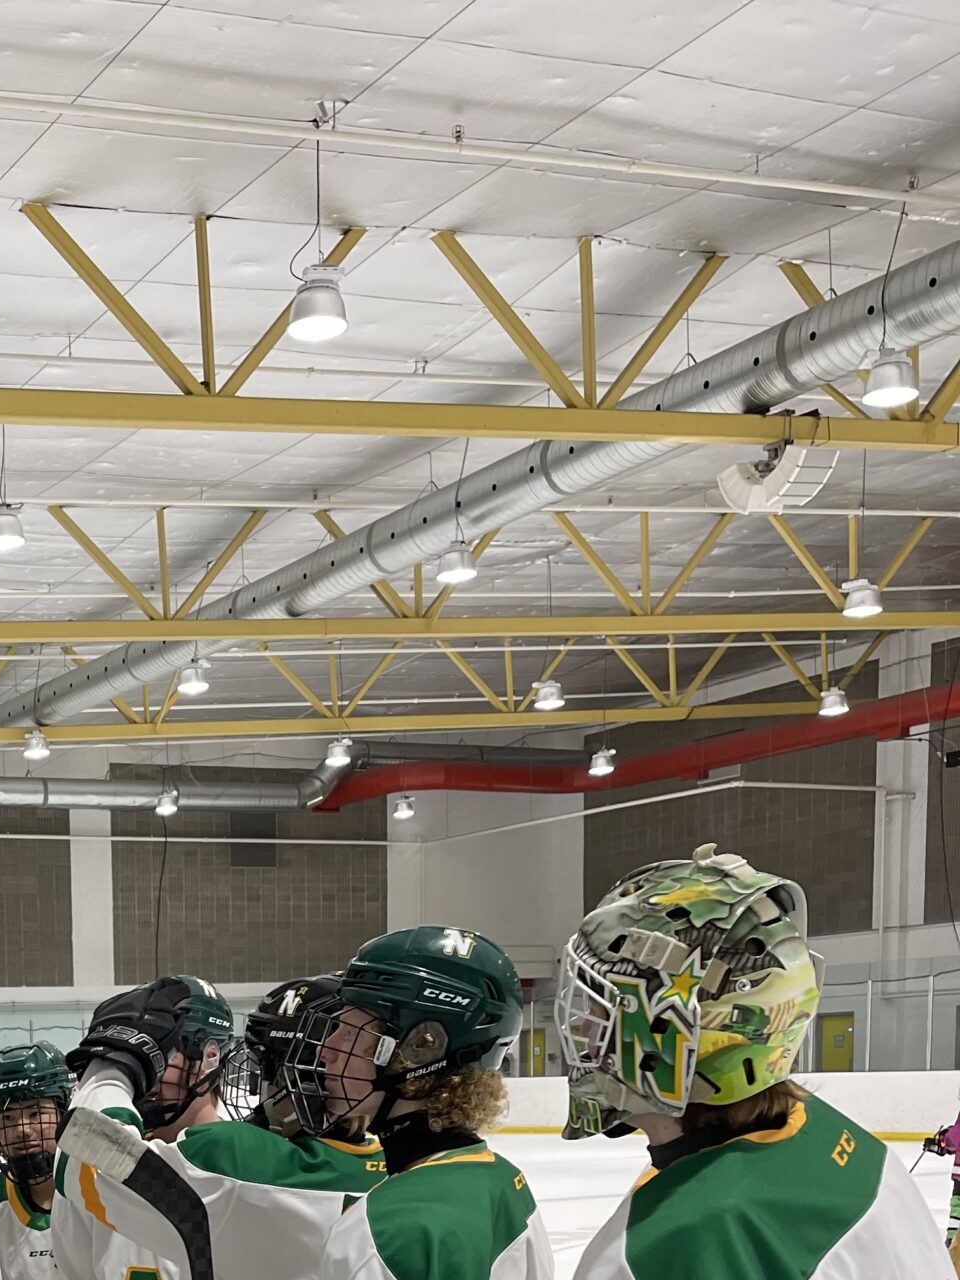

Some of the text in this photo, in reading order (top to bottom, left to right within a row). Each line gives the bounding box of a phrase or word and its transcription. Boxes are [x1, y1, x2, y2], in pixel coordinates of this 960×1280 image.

[442, 929, 477, 959] N
[277, 990, 302, 1017] N
[423, 987, 471, 1006] CCM
[208, 1016, 231, 1028] CCM
[607, 974, 694, 1109] N
[406, 1060, 447, 1079] BAUER
[0, 1079, 29, 1089] CCM
